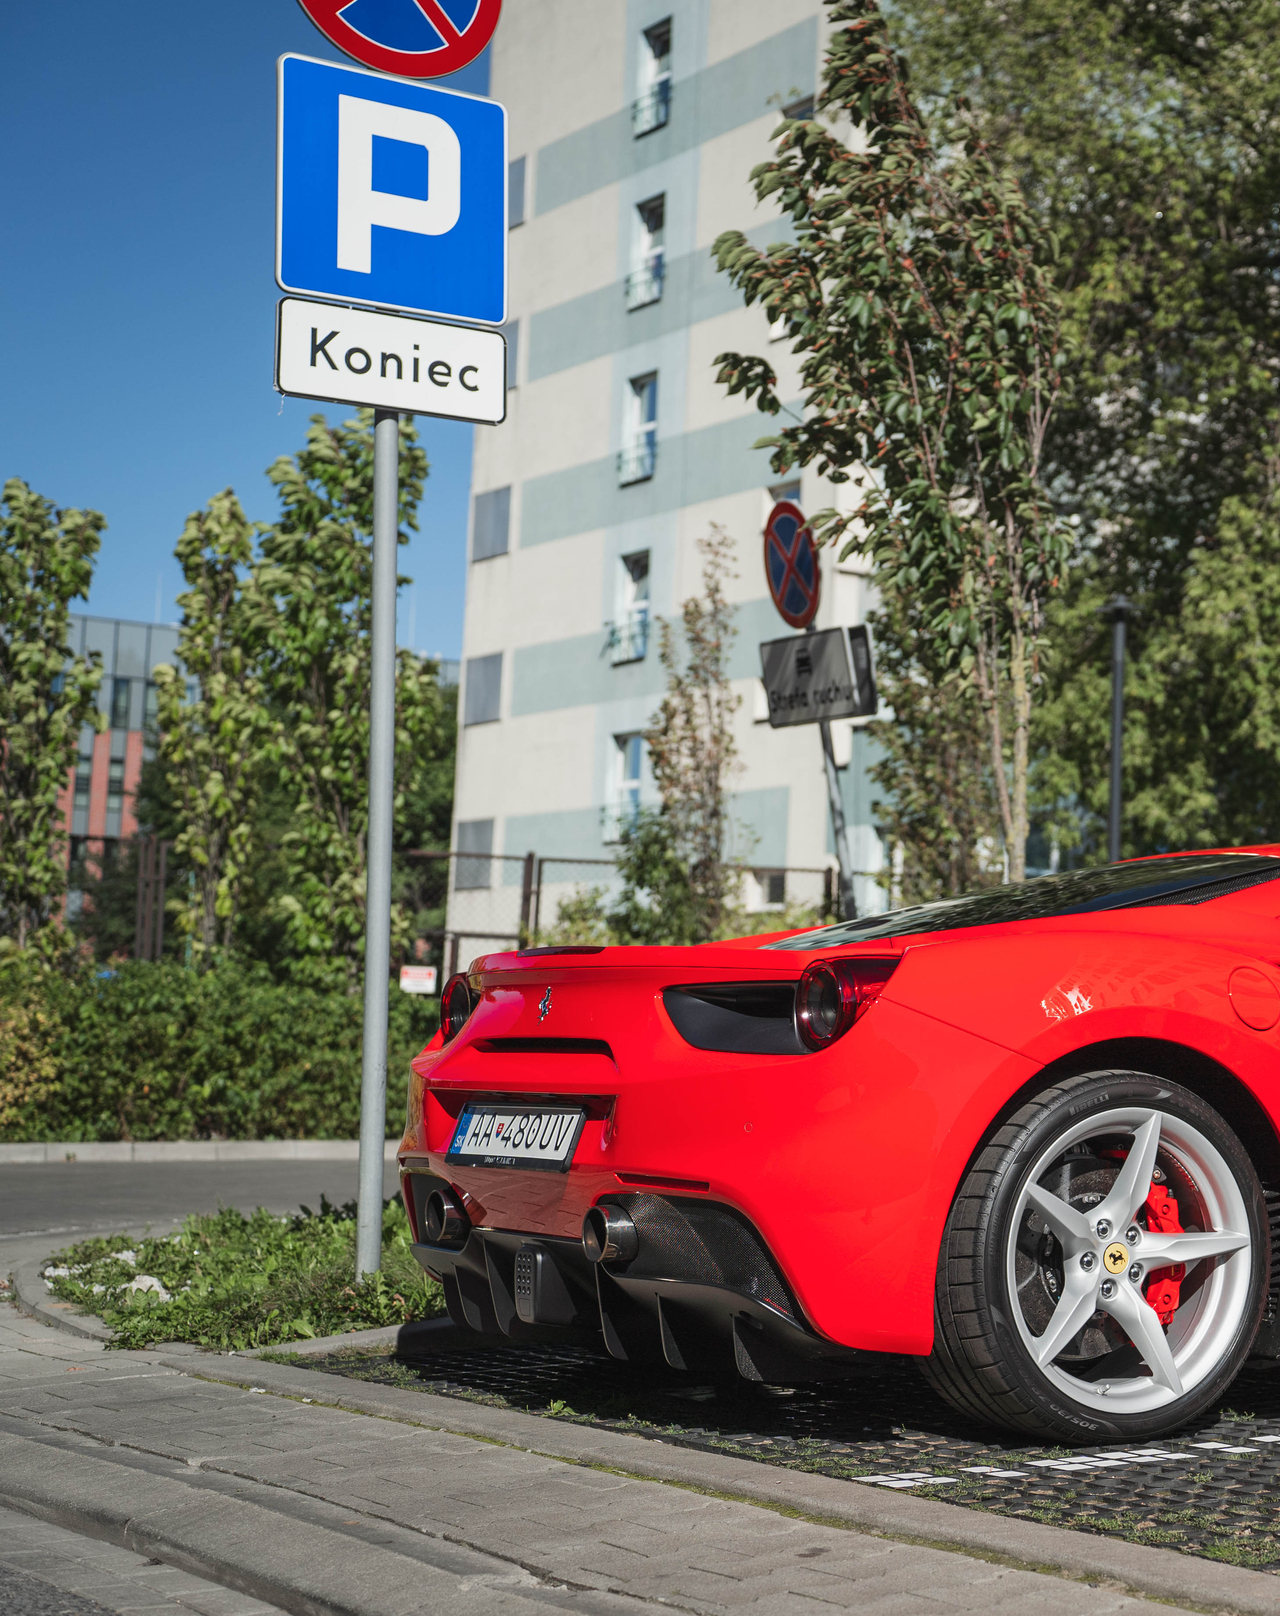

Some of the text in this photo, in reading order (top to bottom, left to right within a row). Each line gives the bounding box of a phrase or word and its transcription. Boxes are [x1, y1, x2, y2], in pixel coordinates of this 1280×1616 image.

[337, 93, 461, 274] P
[310, 326, 480, 392] Koniec
[454, 1135, 466, 1147] SK
